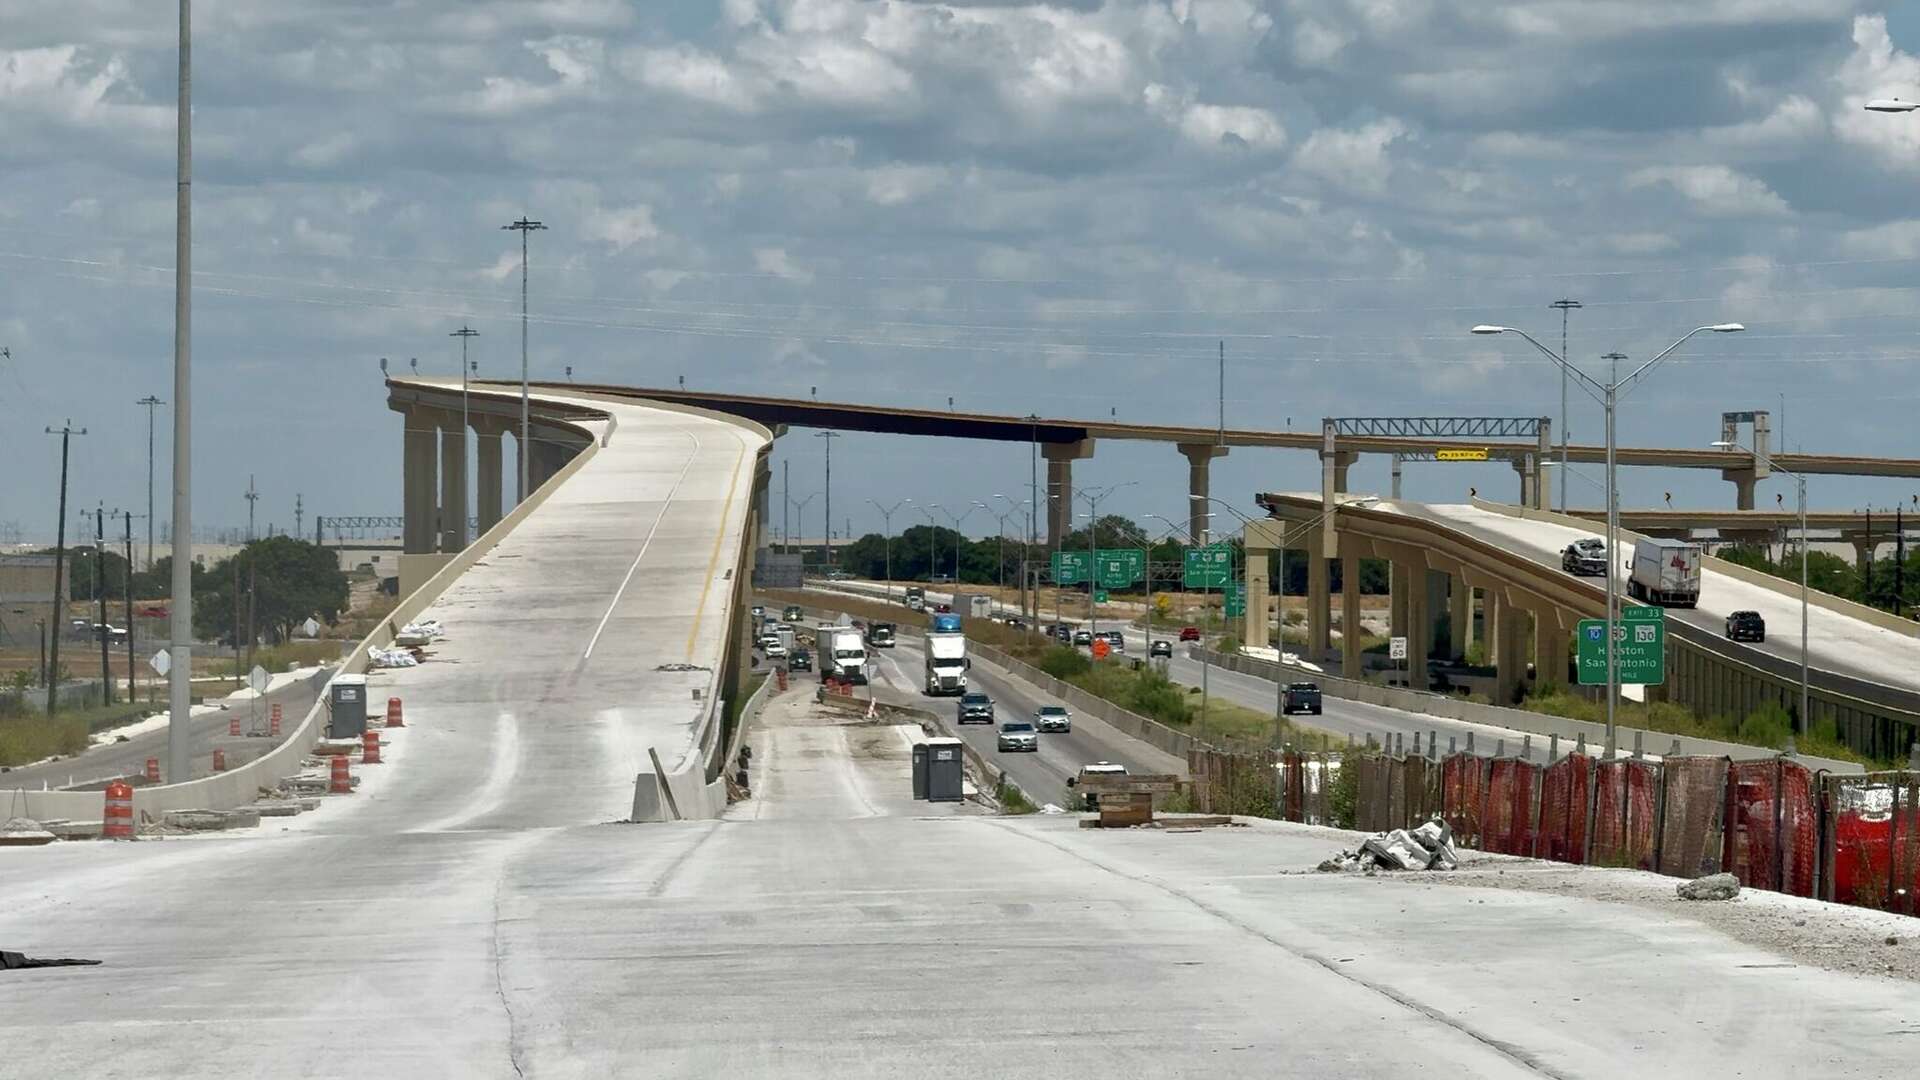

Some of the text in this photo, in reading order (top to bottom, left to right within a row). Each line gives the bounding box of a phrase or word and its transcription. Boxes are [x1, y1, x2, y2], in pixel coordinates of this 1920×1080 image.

[1648, 608, 1659, 617] 33
[1589, 629, 1600, 639] 10
[1637, 631, 1654, 641] 130
[1393, 649, 1404, 657] 60
[1598, 647, 1645, 655] Huston
[1585, 658, 1606, 667] San
